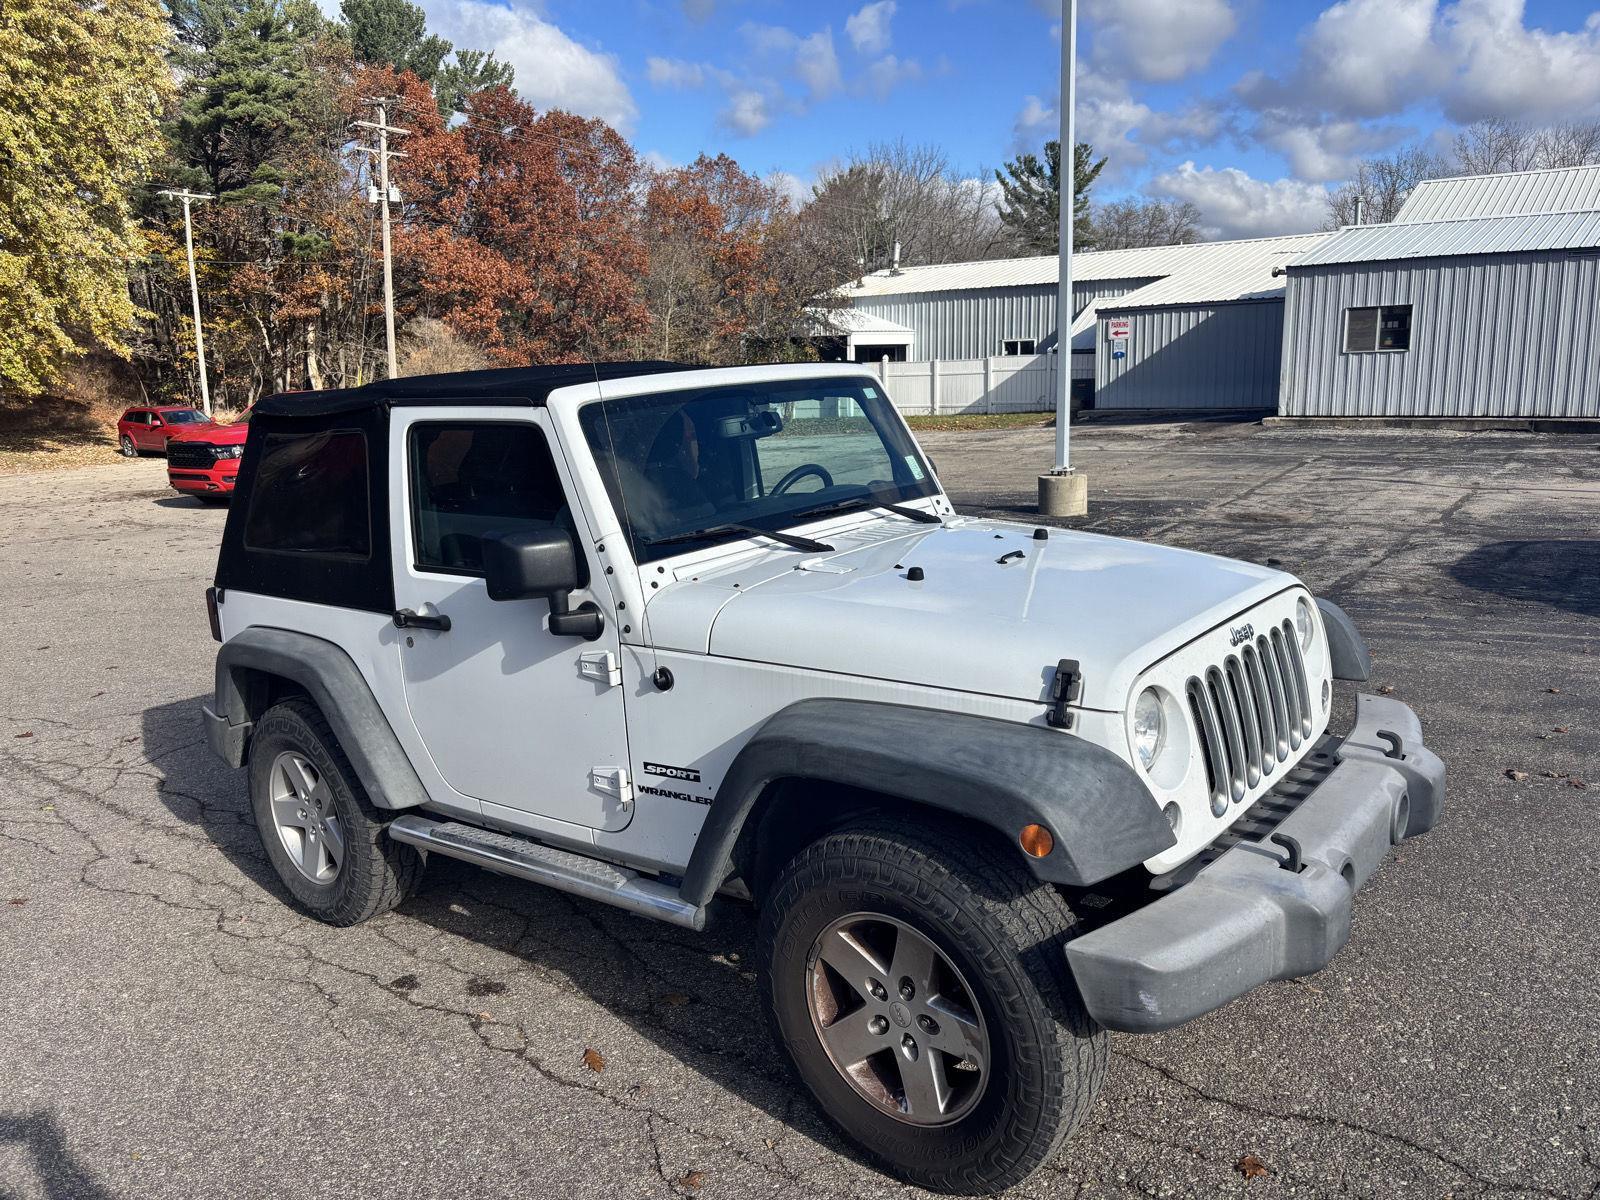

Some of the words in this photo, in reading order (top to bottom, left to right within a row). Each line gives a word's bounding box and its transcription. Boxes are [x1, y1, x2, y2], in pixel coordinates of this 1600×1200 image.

[1230, 623, 1254, 647] Jeep
[643, 764, 700, 780] SPORT
[637, 785, 713, 806] WRANGLER
